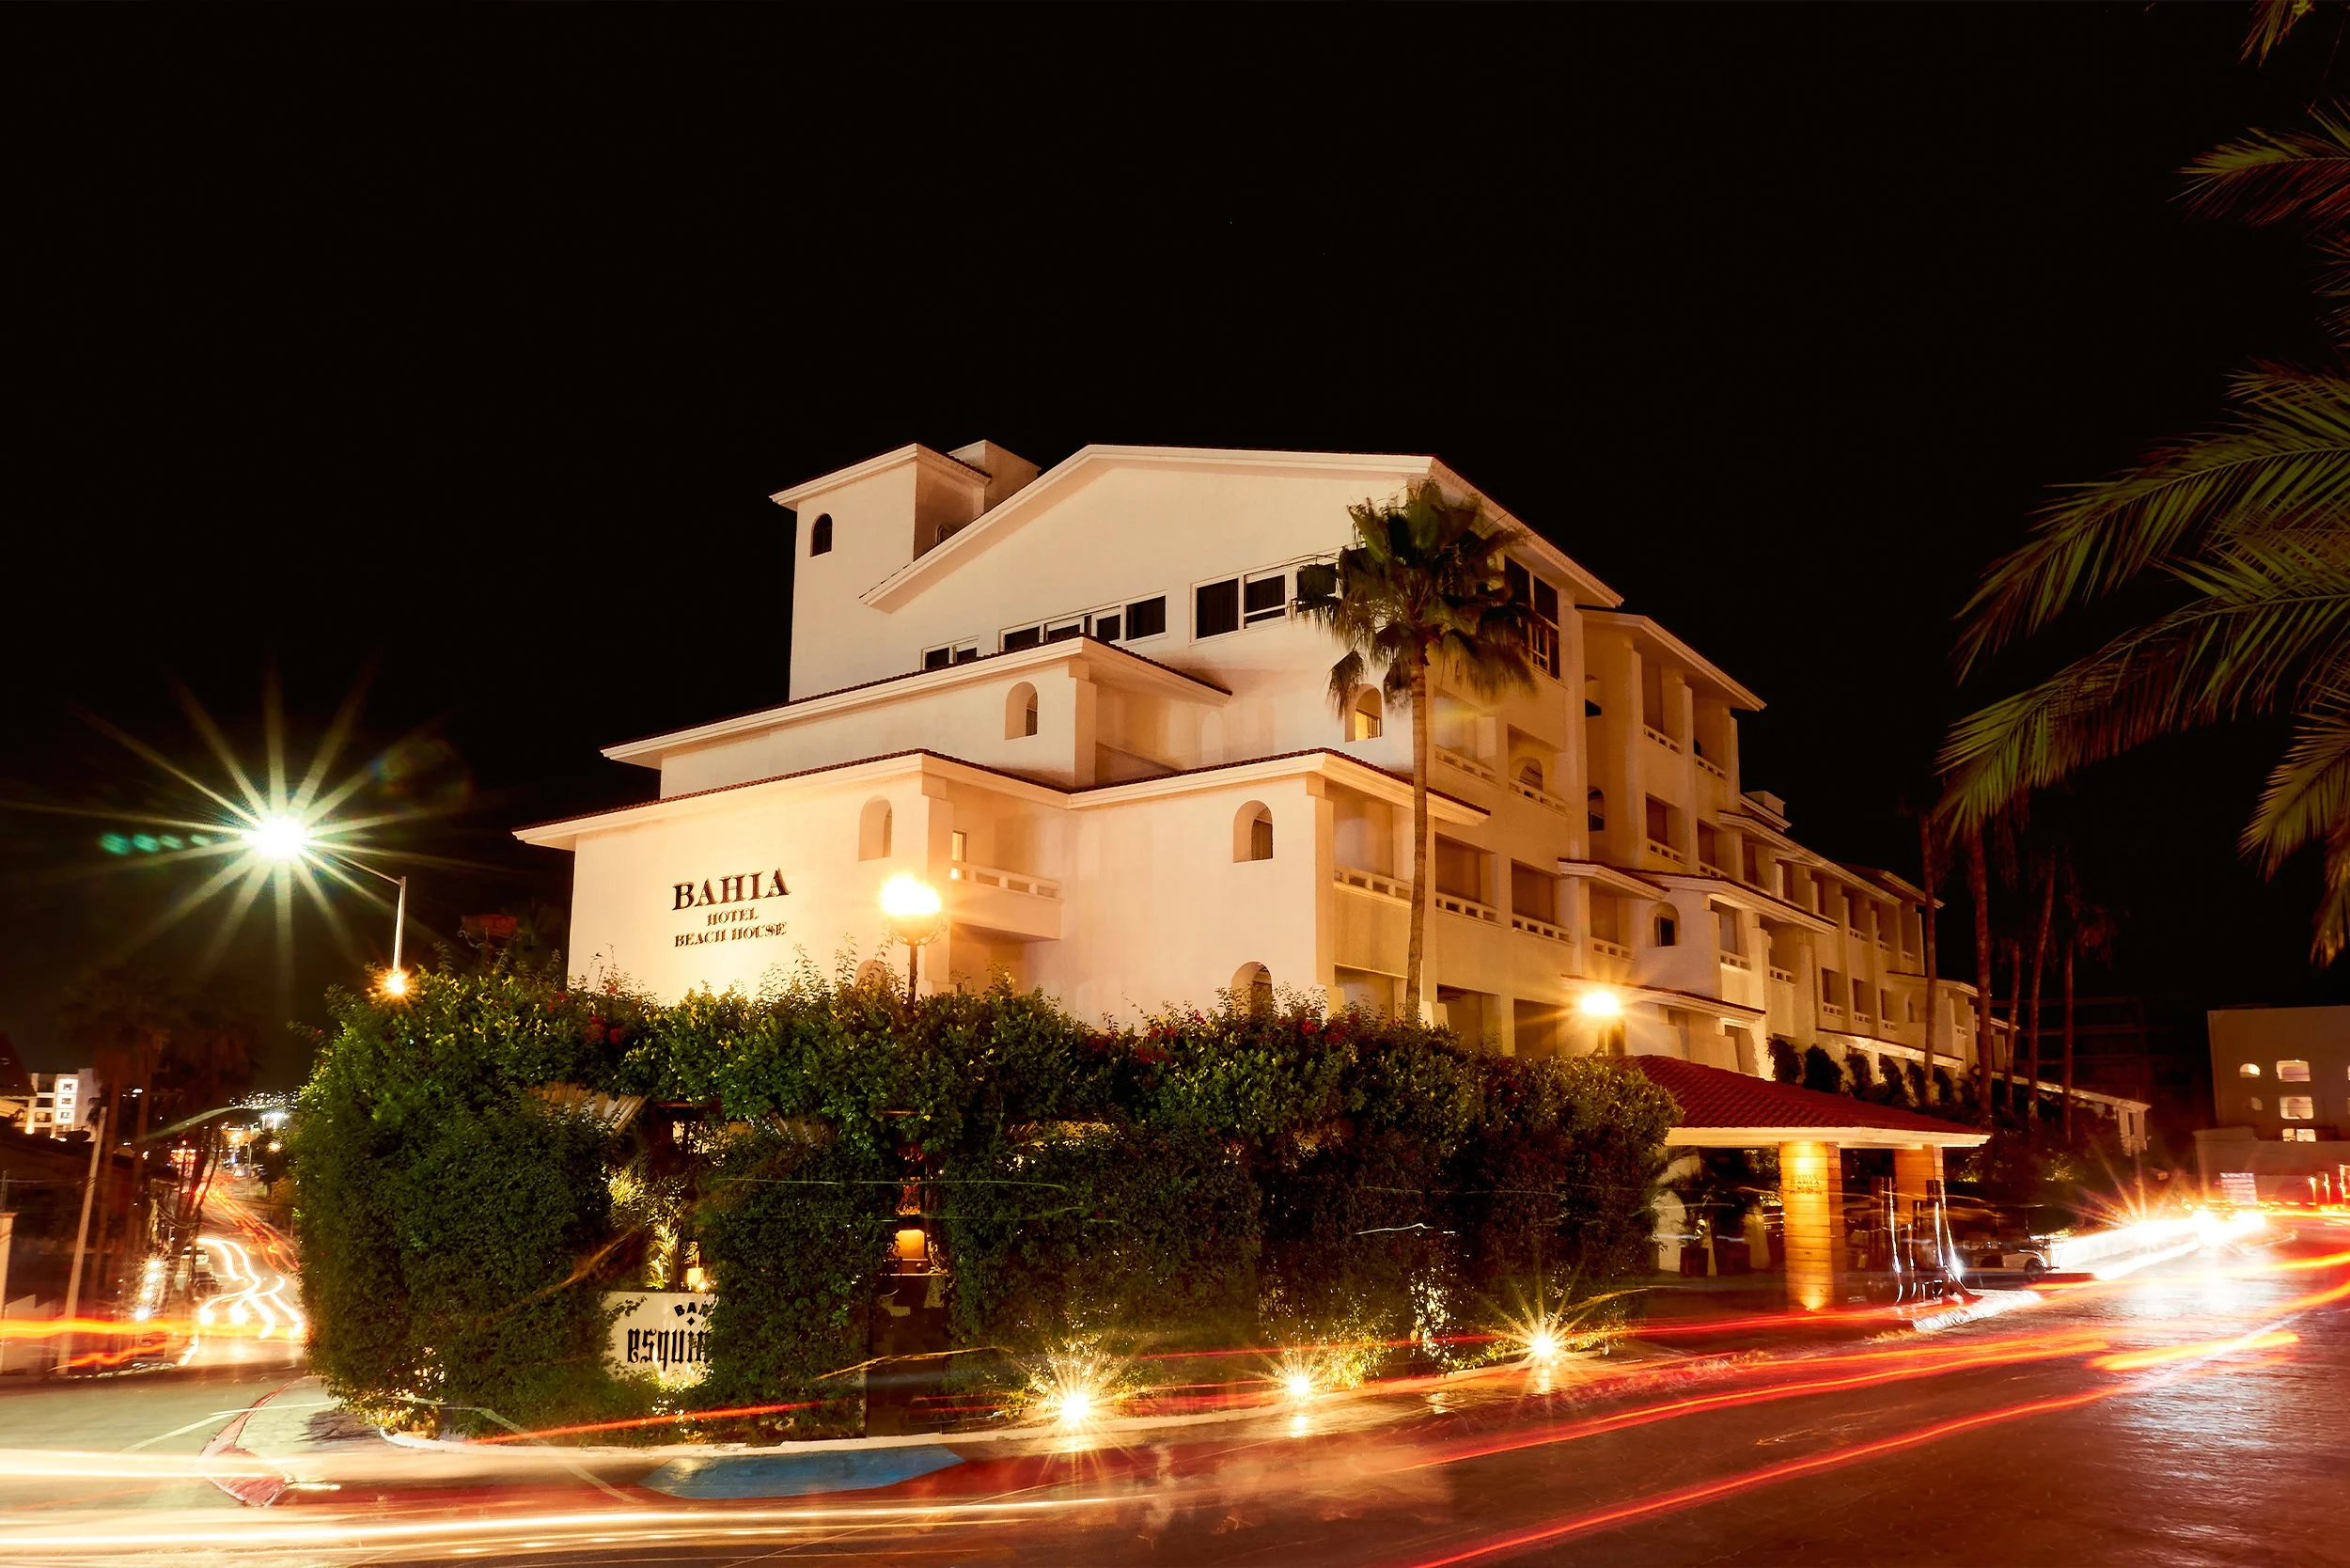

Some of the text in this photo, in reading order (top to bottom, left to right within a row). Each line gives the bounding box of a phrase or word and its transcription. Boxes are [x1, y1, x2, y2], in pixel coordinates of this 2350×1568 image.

[672, 868, 791, 910] BAHIA
[707, 908, 759, 926] HOTEL
[675, 922, 787, 948] BEACH HOUSE
